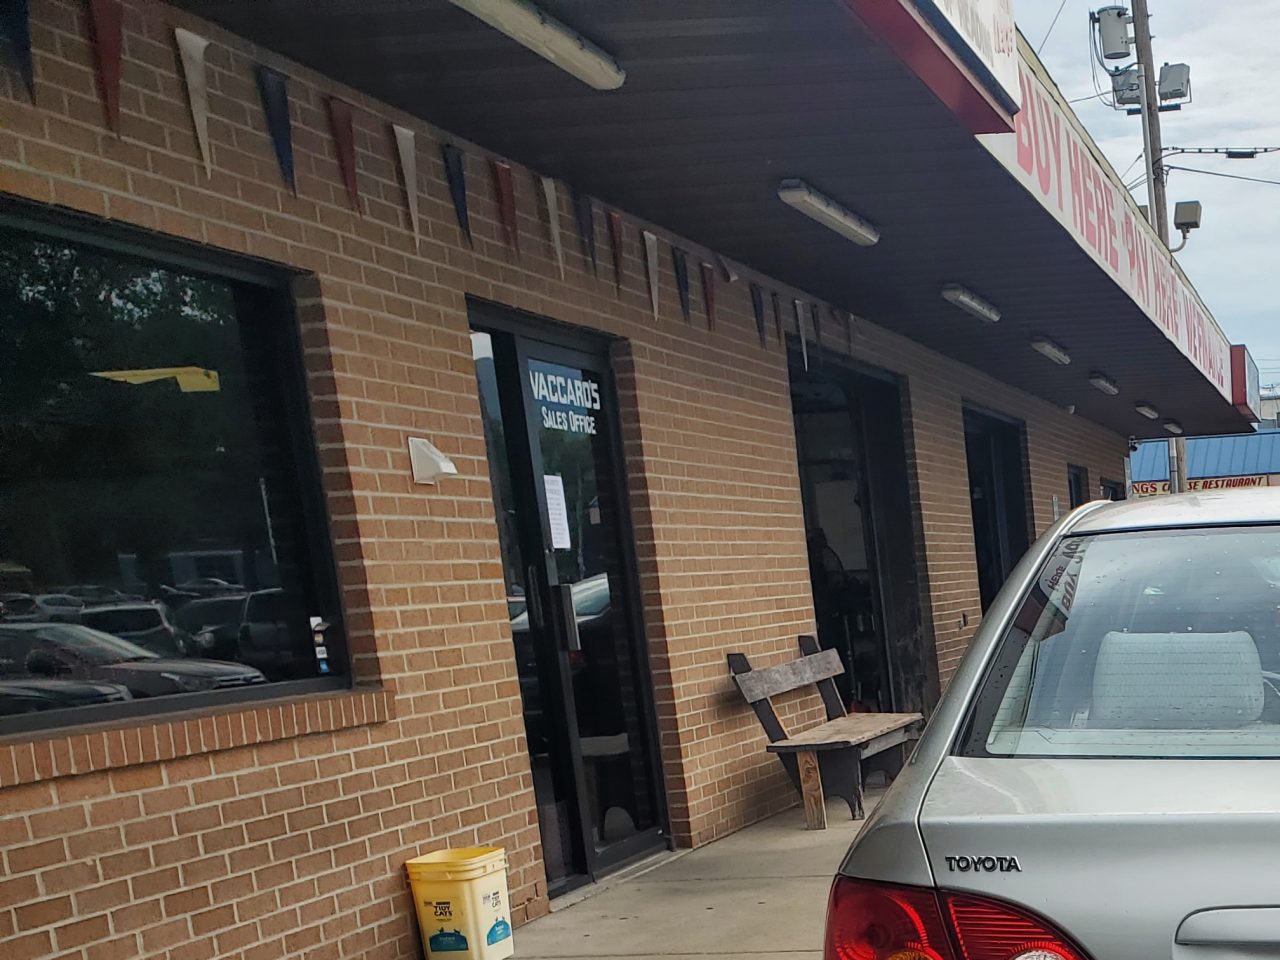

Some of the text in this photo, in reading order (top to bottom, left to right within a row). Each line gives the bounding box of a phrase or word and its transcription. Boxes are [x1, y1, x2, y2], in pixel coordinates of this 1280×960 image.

[1016, 62, 1064, 211] BUY
[1065, 130, 1119, 274] HERE
[1150, 245, 1179, 341] HERE
[529, 370, 600, 410] VACCARO'S
[1202, 476, 1265, 490] RESTAURANT
[945, 856, 1022, 872] TOYOTA
